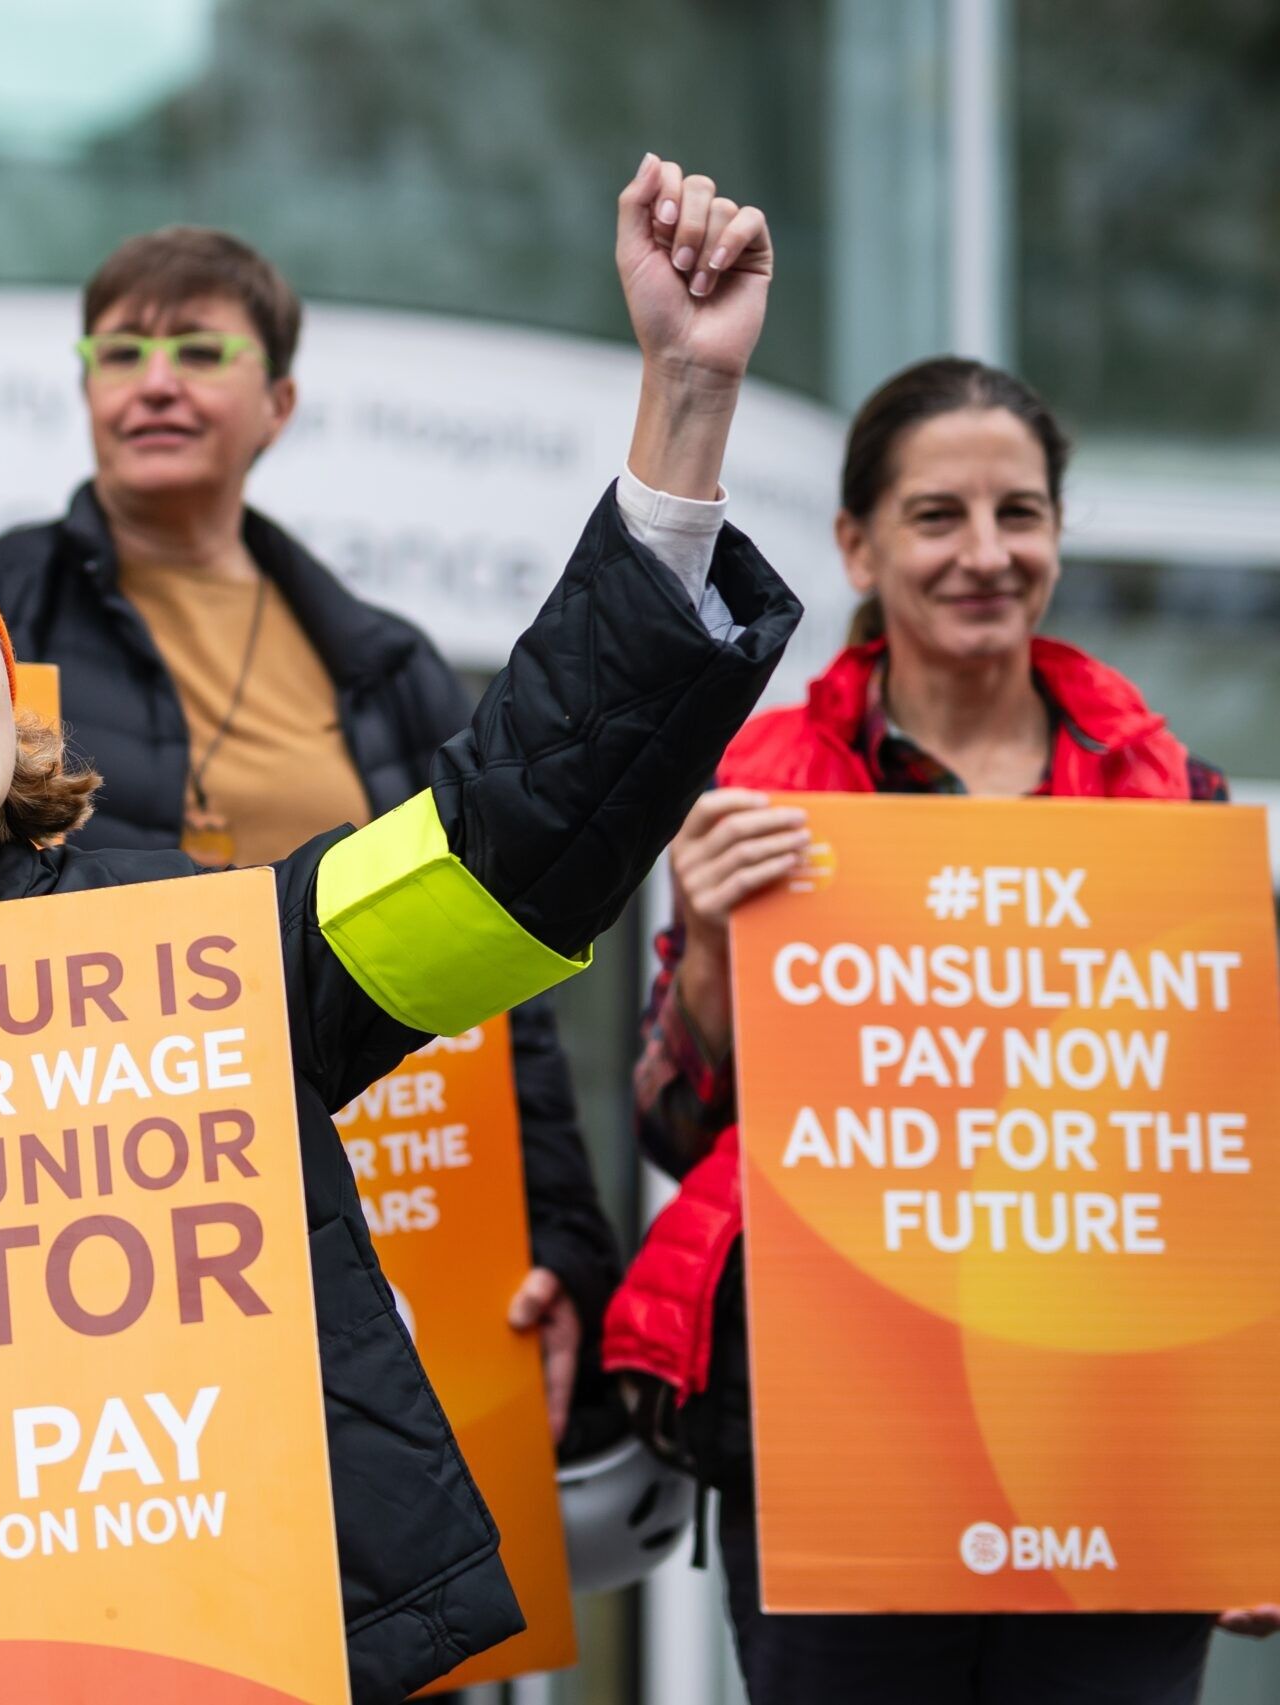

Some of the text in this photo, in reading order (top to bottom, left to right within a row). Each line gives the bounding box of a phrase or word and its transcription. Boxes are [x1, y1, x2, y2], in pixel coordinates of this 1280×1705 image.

[926, 866, 1090, 928] #FIX
[156, 935, 243, 1017] IS
[773, 943, 1240, 1010] CONSULTANT
[31, 1027, 251, 1110] WAGE
[860, 1026, 1168, 1089] PAY NOW
[381, 1123, 473, 1176] THE
[783, 1107, 1250, 1173] AND FOR THE
[884, 1190, 1164, 1253] FUTURE
[13, 1386, 222, 1500] PAY
[94, 1492, 227, 1548] NOW
[1012, 1526, 1118, 1571] BMA
